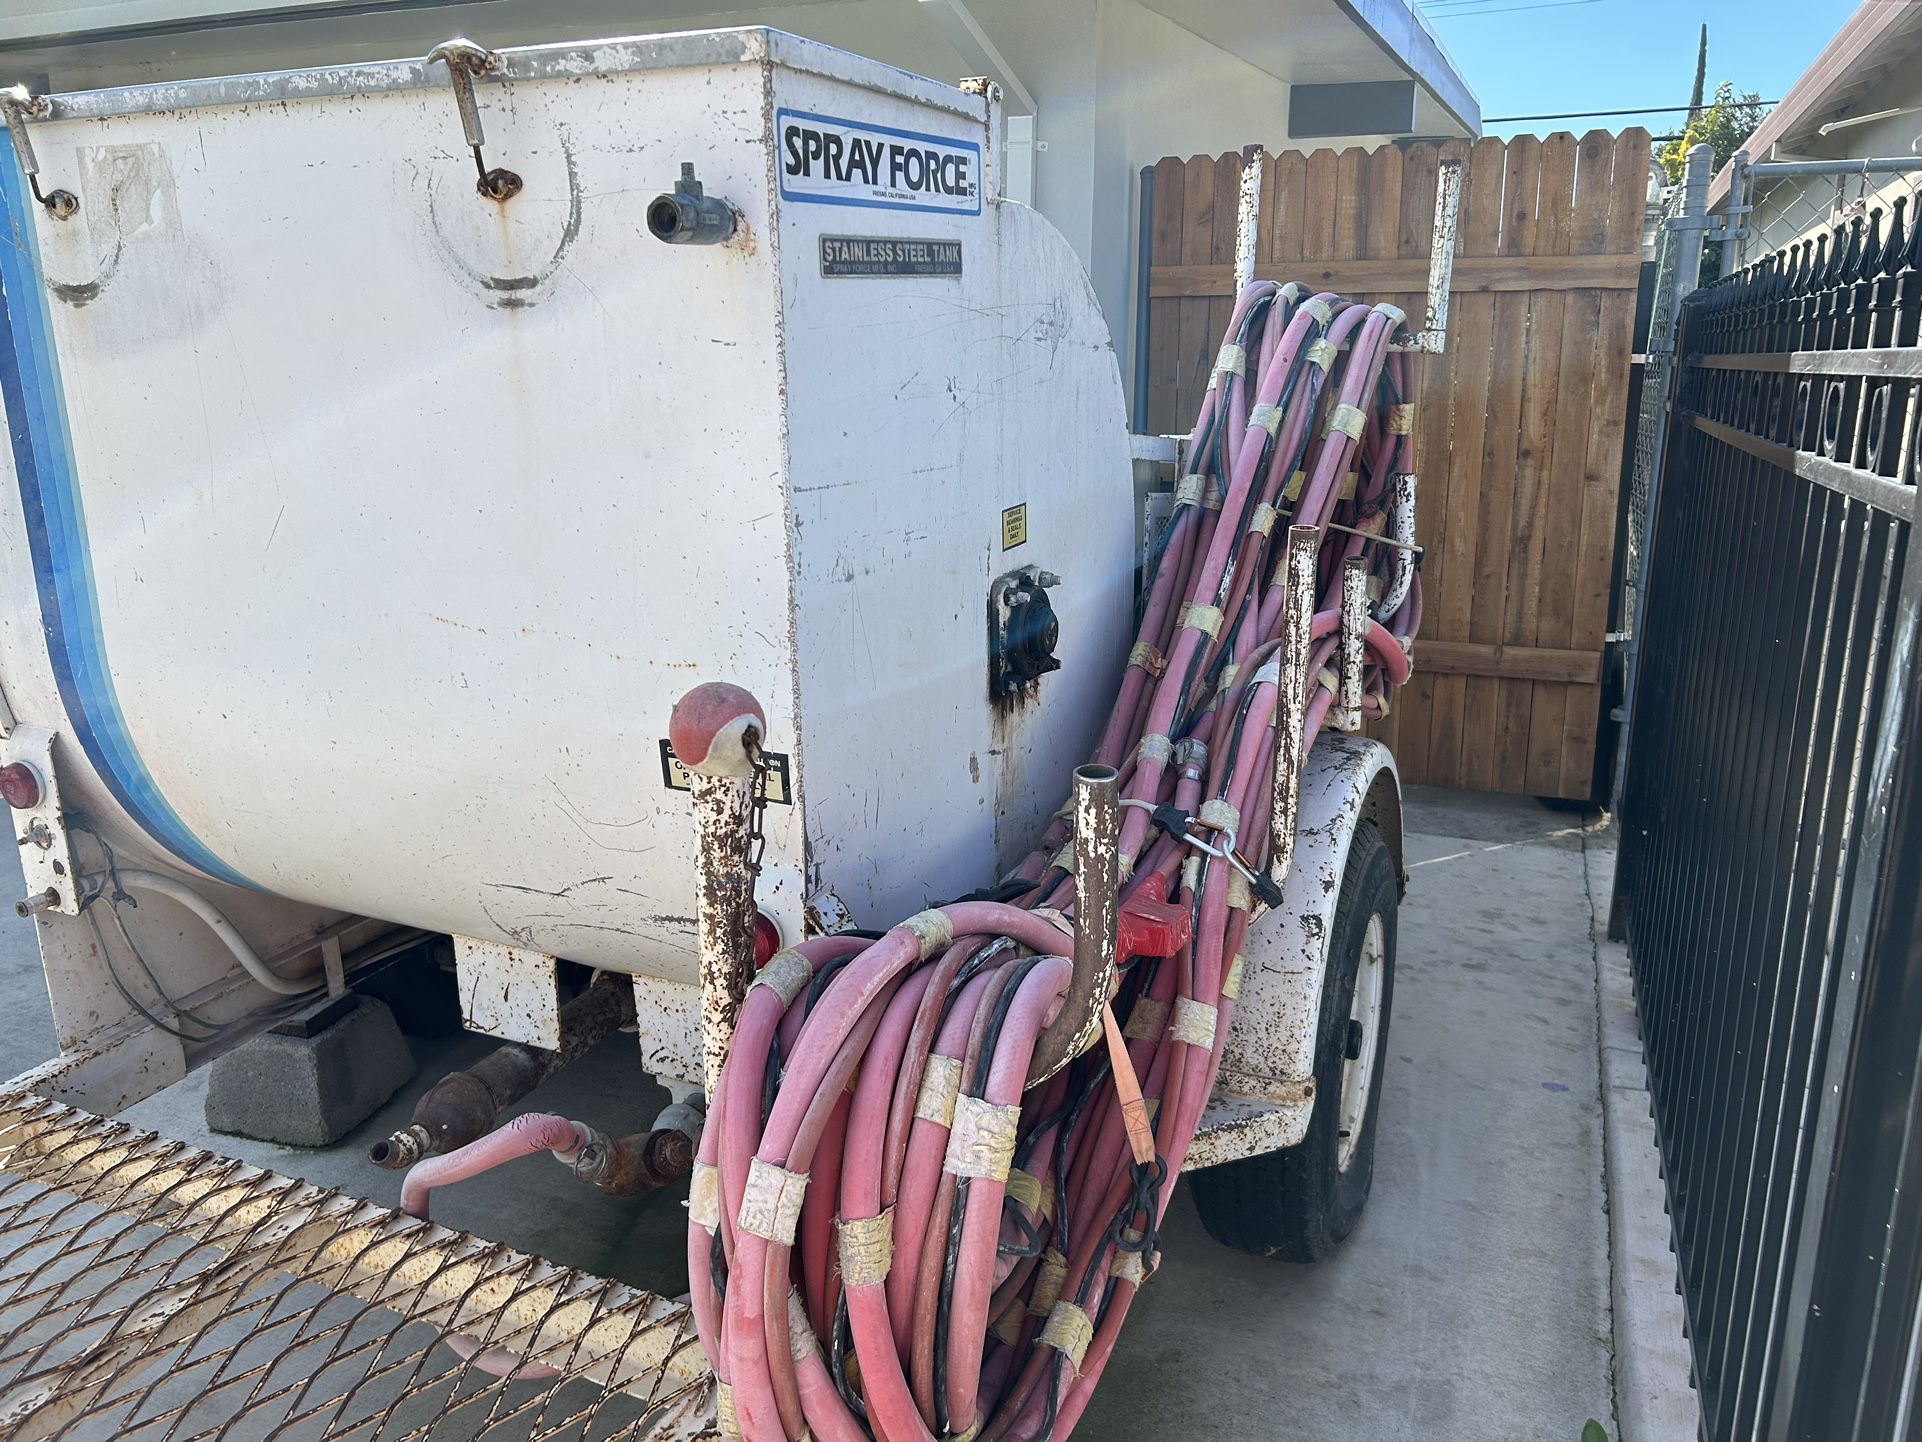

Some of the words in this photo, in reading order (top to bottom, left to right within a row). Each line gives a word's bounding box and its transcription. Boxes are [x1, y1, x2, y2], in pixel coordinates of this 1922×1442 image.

[785, 125, 884, 186] SPRAY
[889, 144, 968, 196] FORCE
[824, 240, 894, 262] STAINLESS
[896, 242, 931, 262] STEEL
[932, 245, 960, 263] TANK
